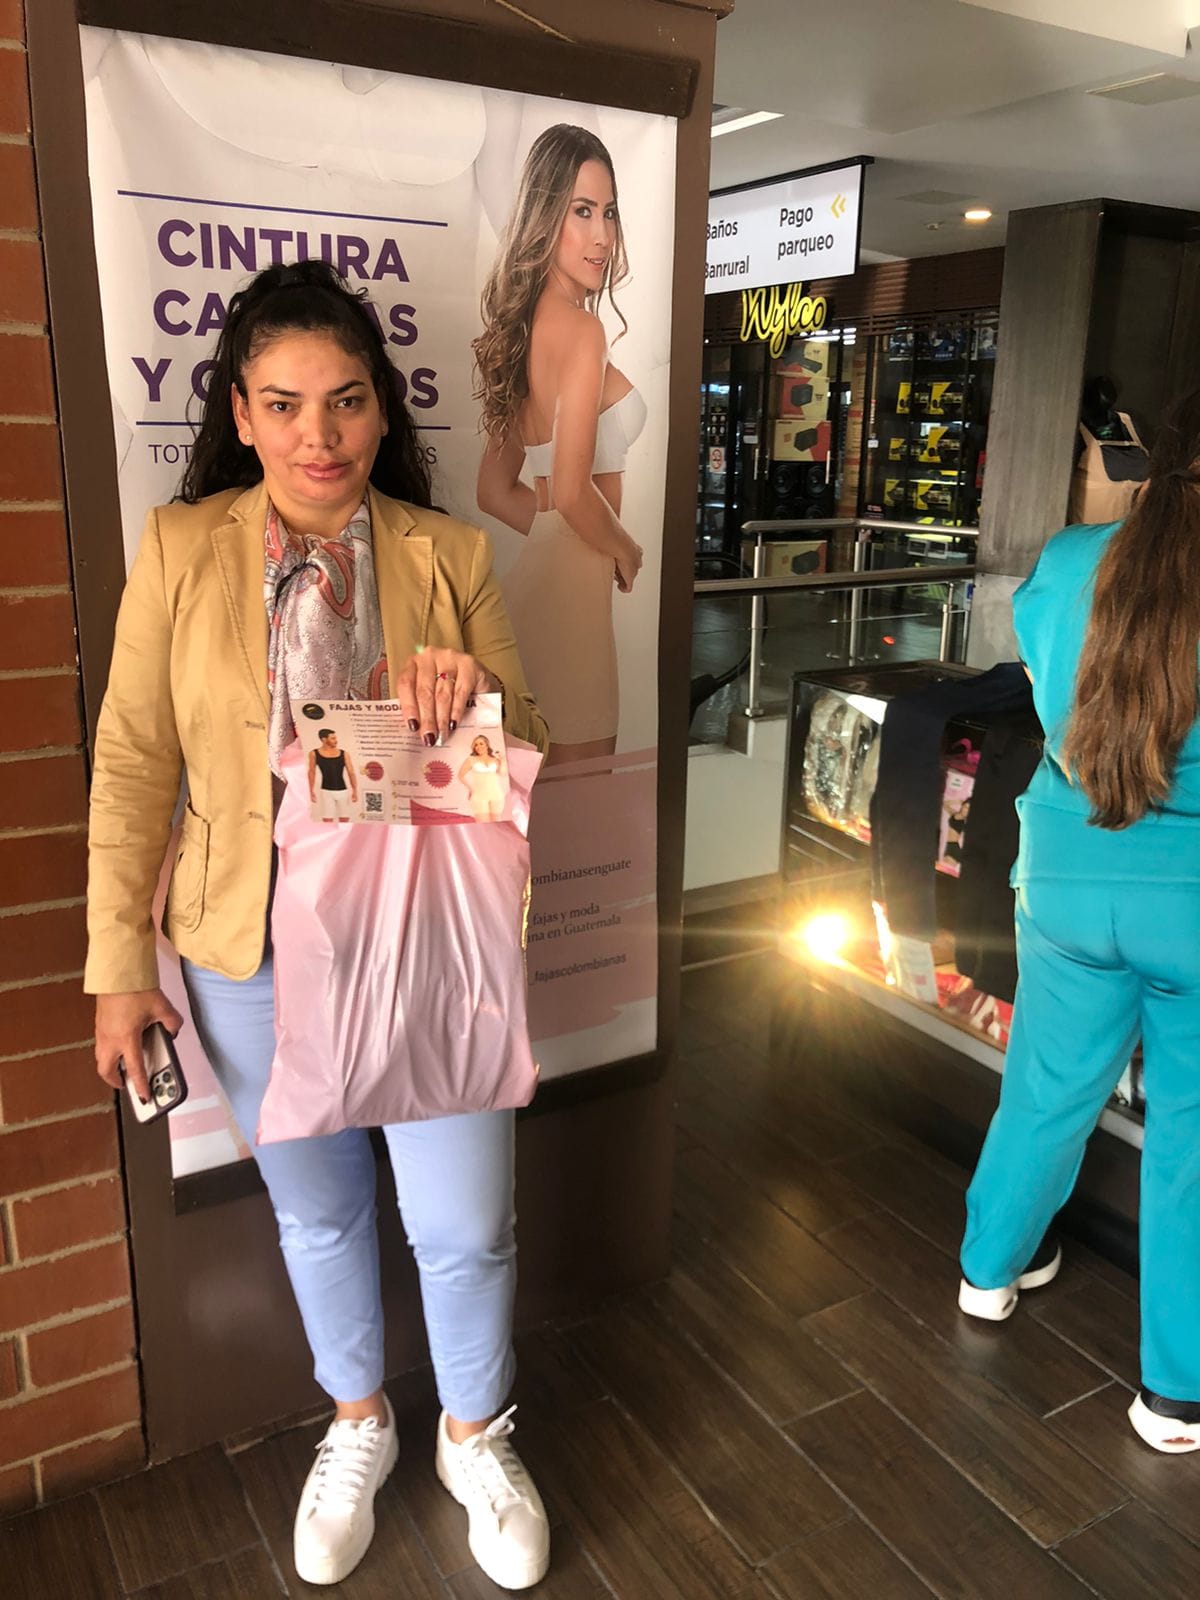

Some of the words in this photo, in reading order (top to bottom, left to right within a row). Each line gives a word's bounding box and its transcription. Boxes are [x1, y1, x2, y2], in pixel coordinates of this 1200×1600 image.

[779, 207, 814, 228] Pago
[157, 219, 410, 283] CINTURA
[777, 233, 834, 260] parqueo
[375, 704, 402, 712] MOD
[532, 912, 558, 926] fajas
[560, 911, 566, 924] y
[569, 903, 600, 919] moda
[547, 928, 561, 939] en
[564, 914, 622, 936] Guatemala
